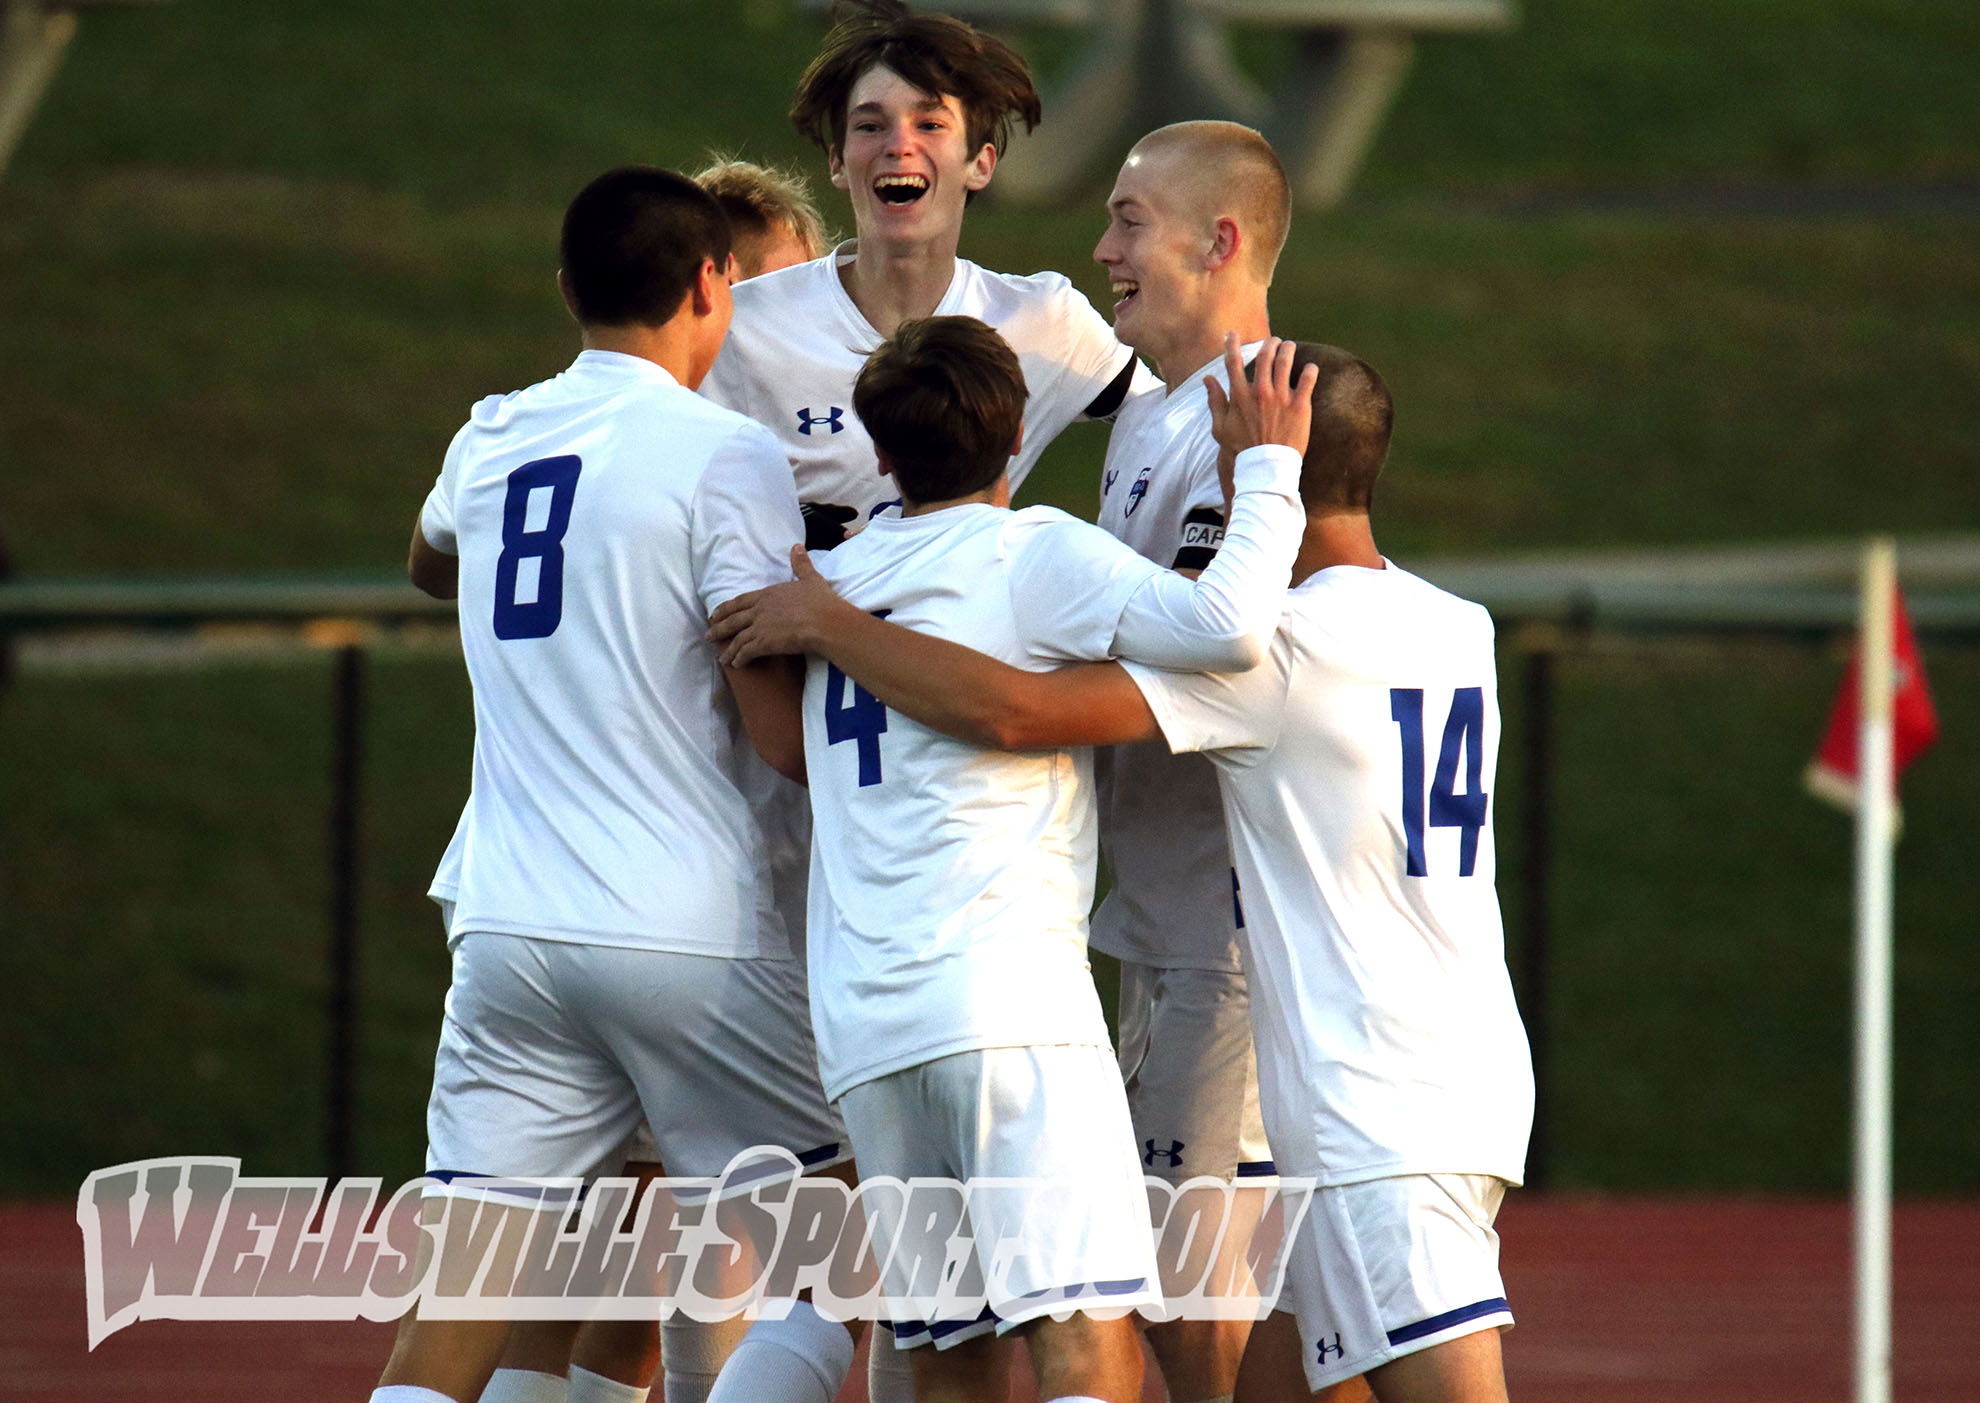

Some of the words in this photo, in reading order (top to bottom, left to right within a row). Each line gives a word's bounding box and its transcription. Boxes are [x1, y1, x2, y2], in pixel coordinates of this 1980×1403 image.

[493, 454, 582, 640] 8
[825, 609, 893, 787] 4
[1390, 687, 1488, 877] 14
